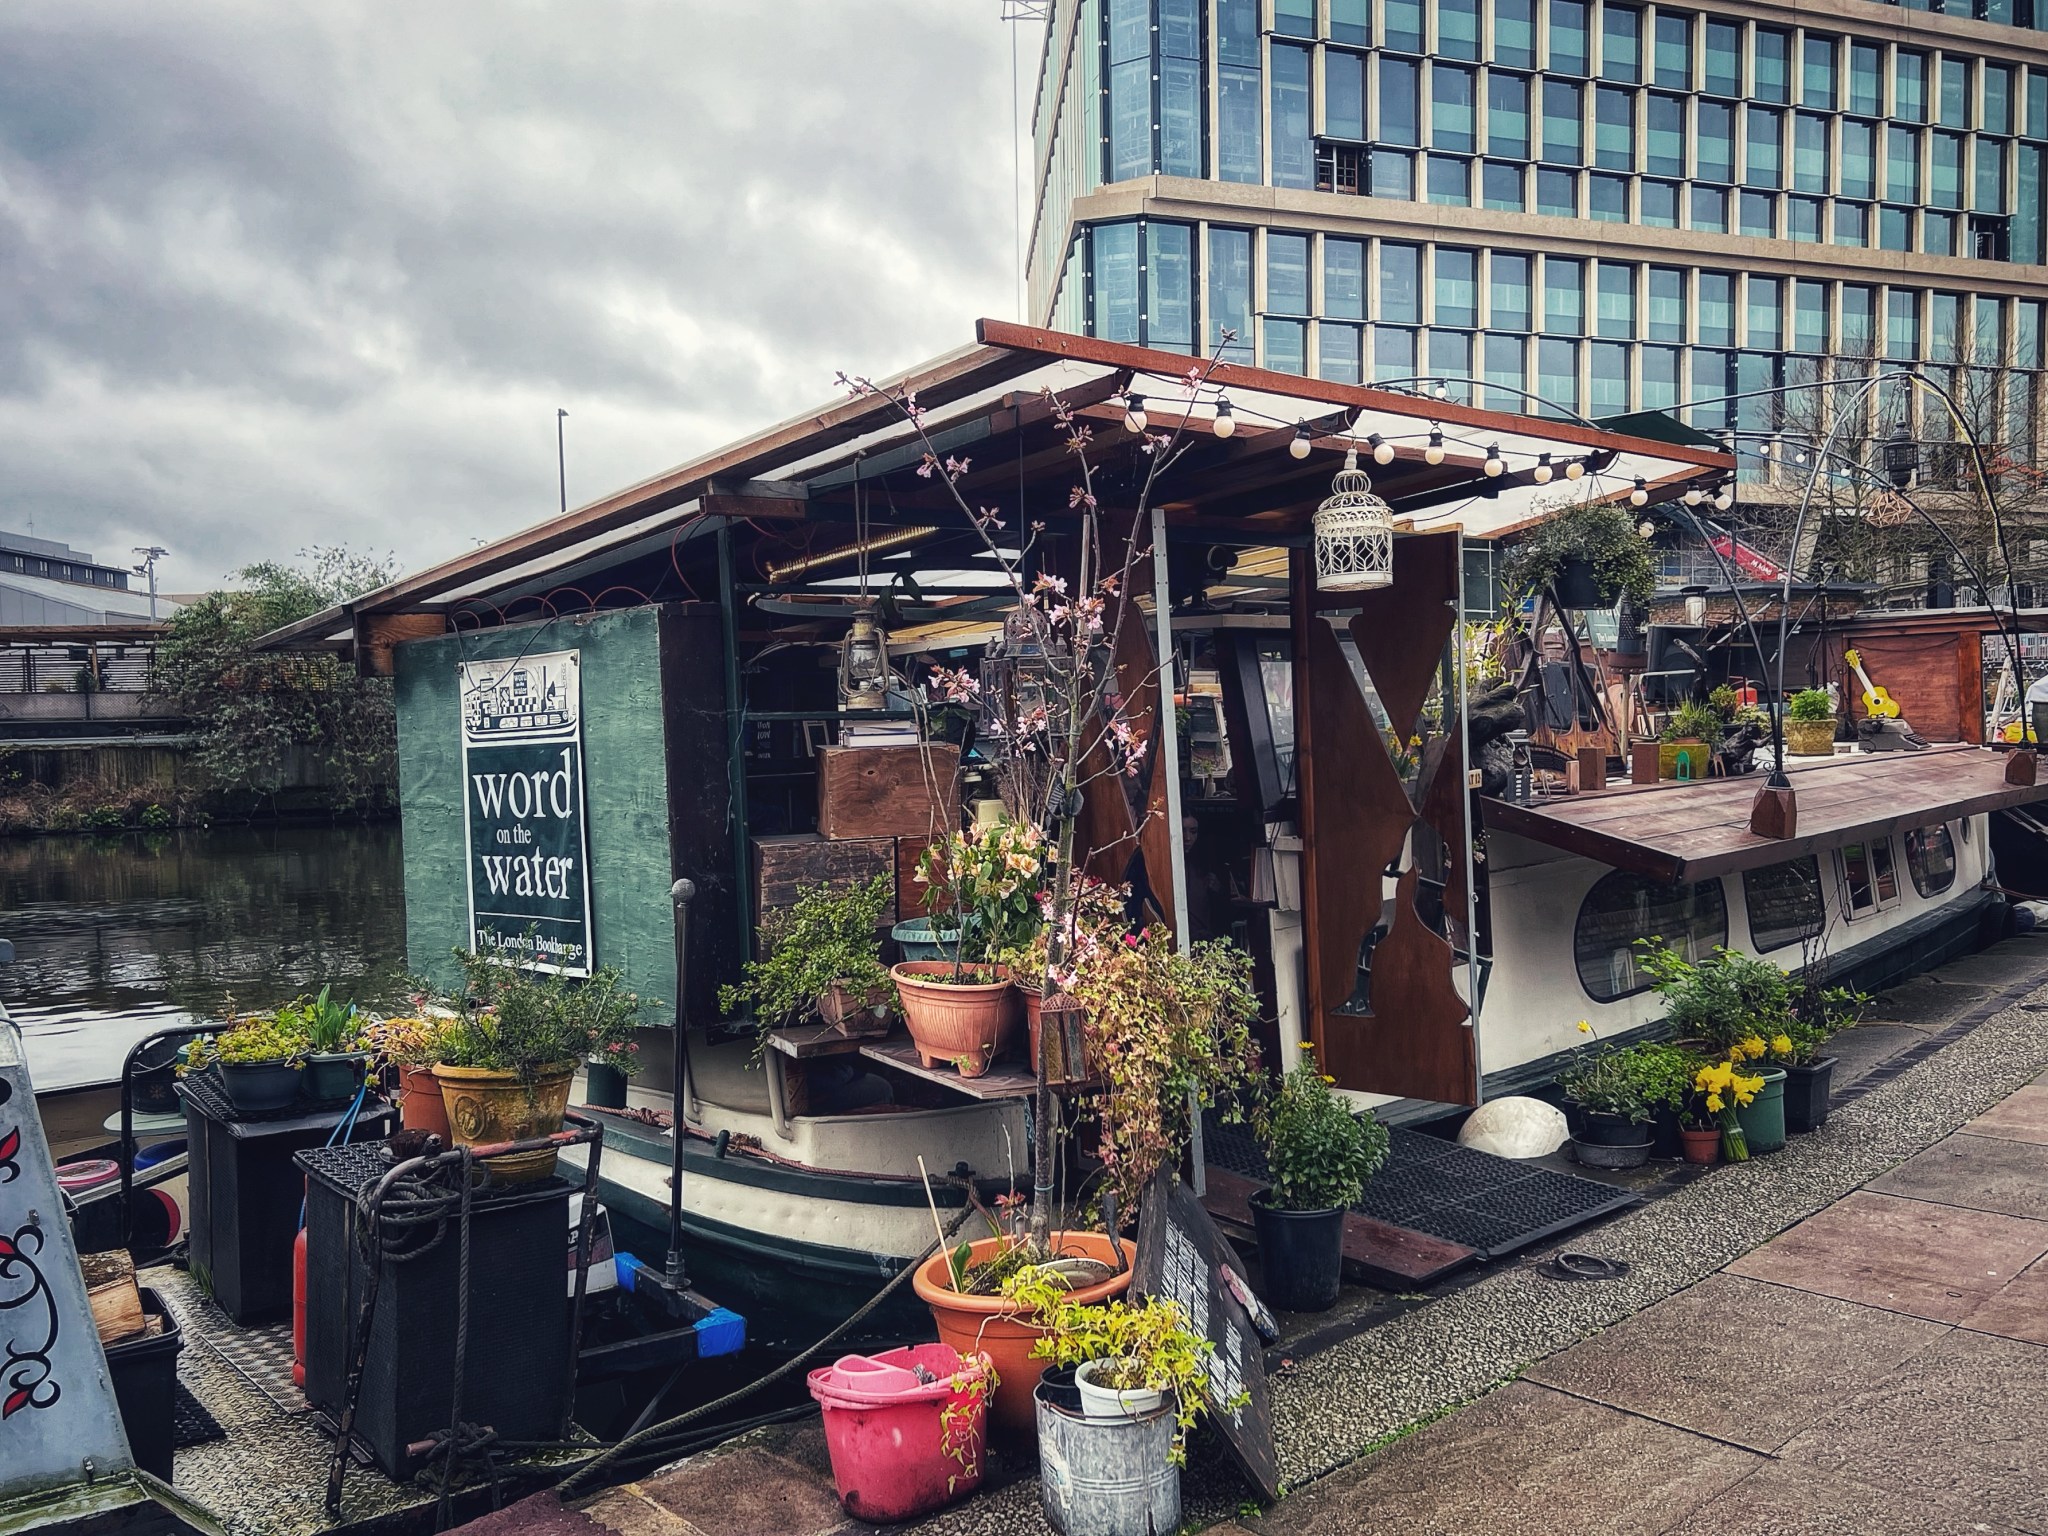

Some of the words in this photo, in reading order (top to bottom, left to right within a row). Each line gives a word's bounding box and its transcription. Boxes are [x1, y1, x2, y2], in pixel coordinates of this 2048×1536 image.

[472, 747, 573, 819] word
[496, 828, 512, 844] on
[512, 823, 532, 844] the
[481, 845, 574, 900] water
[535, 934, 583, 960] Bookbarge
